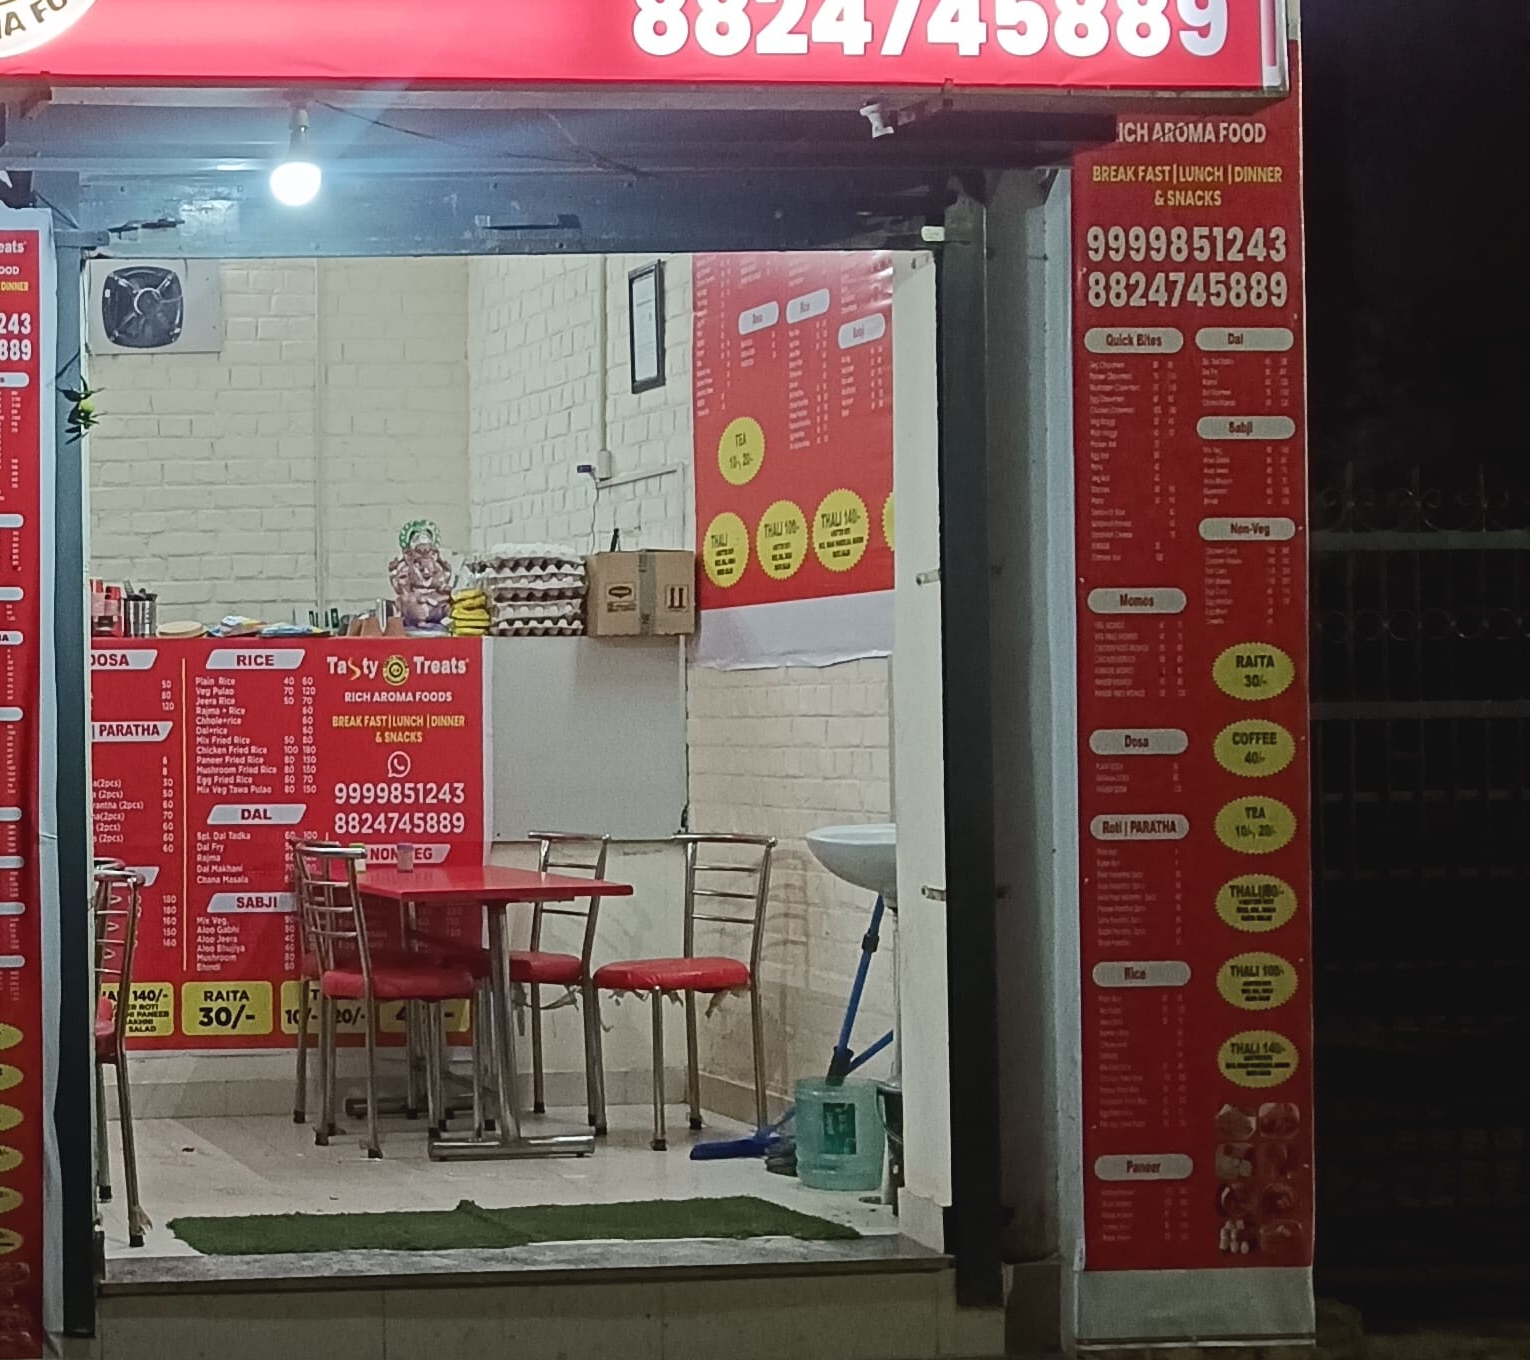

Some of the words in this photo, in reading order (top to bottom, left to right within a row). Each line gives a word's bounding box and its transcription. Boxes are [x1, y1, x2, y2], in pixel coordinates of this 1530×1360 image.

[1118, 122, 1148, 143] ICH
[1152, 123, 1215, 143] AROMA
[1219, 123, 1267, 143] FOOD
[1093, 166, 1135, 182] BREAK
[1154, 191, 1164, 206] &
[1167, 190, 1221, 206] SNACKS
[1087, 226, 1286, 262] 9999851243
[1088, 272, 1287, 307] 8824745889
[1106, 334, 1133, 346] Quick
[1120, 594, 1154, 607] Momos
[236, 655, 275, 666] RICE
[414, 656, 466, 674] Treats
[1236, 655, 1275, 668] RAITA
[219, 677, 235, 685] Rice
[219, 697, 235, 705] Rice
[345, 692, 370, 702] RICH
[373, 692, 413, 702] AROMA
[415, 692, 452, 702] FOODS
[229, 707, 245, 715] Rice
[332, 715, 362, 727] BREAK
[99, 724, 160, 736] PARATHA
[385, 732, 423, 743] SNACKS
[1232, 732, 1277, 745] COFFEE
[334, 783, 465, 804] 9999851243
[241, 809, 273, 820] DAL
[1245, 807, 1266, 819] TEA
[334, 813, 465, 834] 8824745889
[1130, 820, 1176, 833] PARATHA
[236, 897, 277, 909] SABJI
[204, 991, 249, 1002] RAITA
[198, 1005, 255, 1029] 30/-
